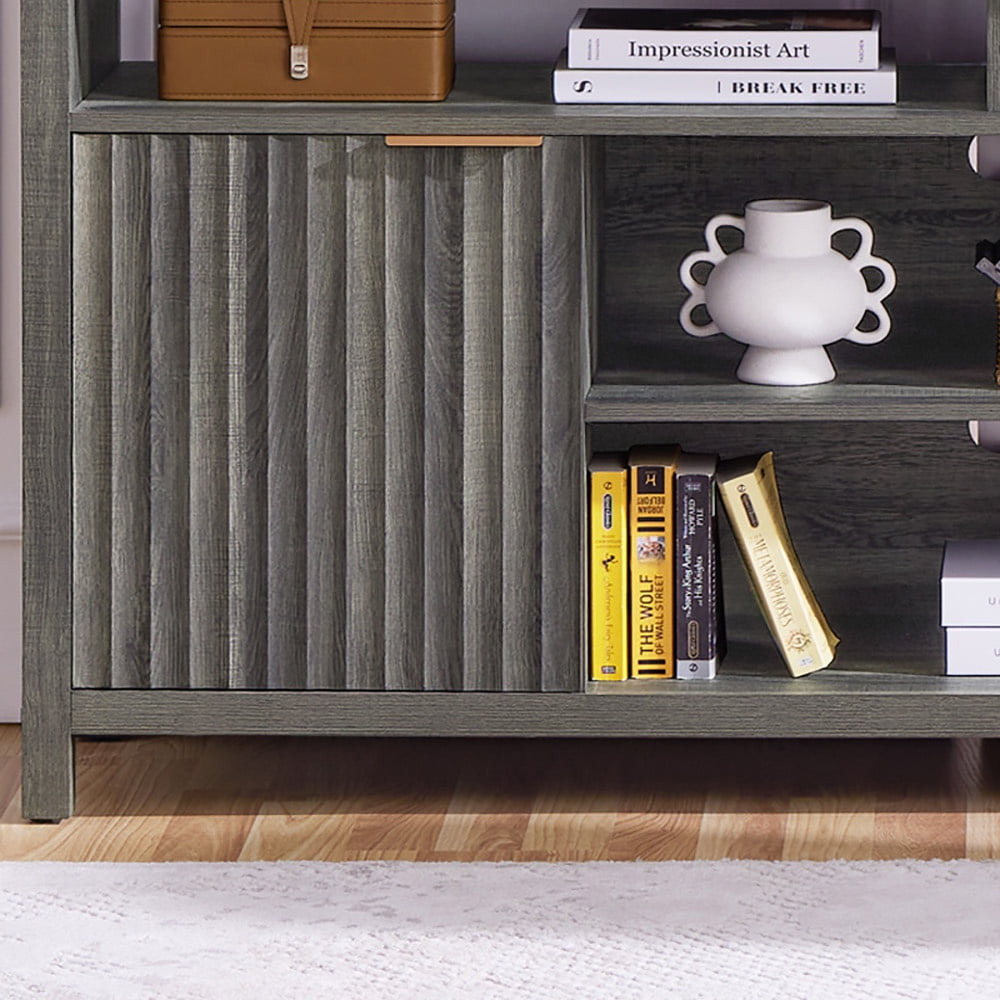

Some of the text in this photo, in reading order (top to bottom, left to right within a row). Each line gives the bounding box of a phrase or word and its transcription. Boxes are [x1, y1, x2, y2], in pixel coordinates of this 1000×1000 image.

[628, 40, 810, 61] Impressionist Art
[732, 82, 867, 94] BREAK FREE
[681, 544, 692, 568] Arthur
[682, 569, 693, 587] King
[693, 555, 705, 584] Knights
[681, 591, 692, 611] Story
[693, 585, 703, 599] His
[639, 574, 654, 656] THE WOLF
[654, 574, 664, 656] OF WALL STREET
